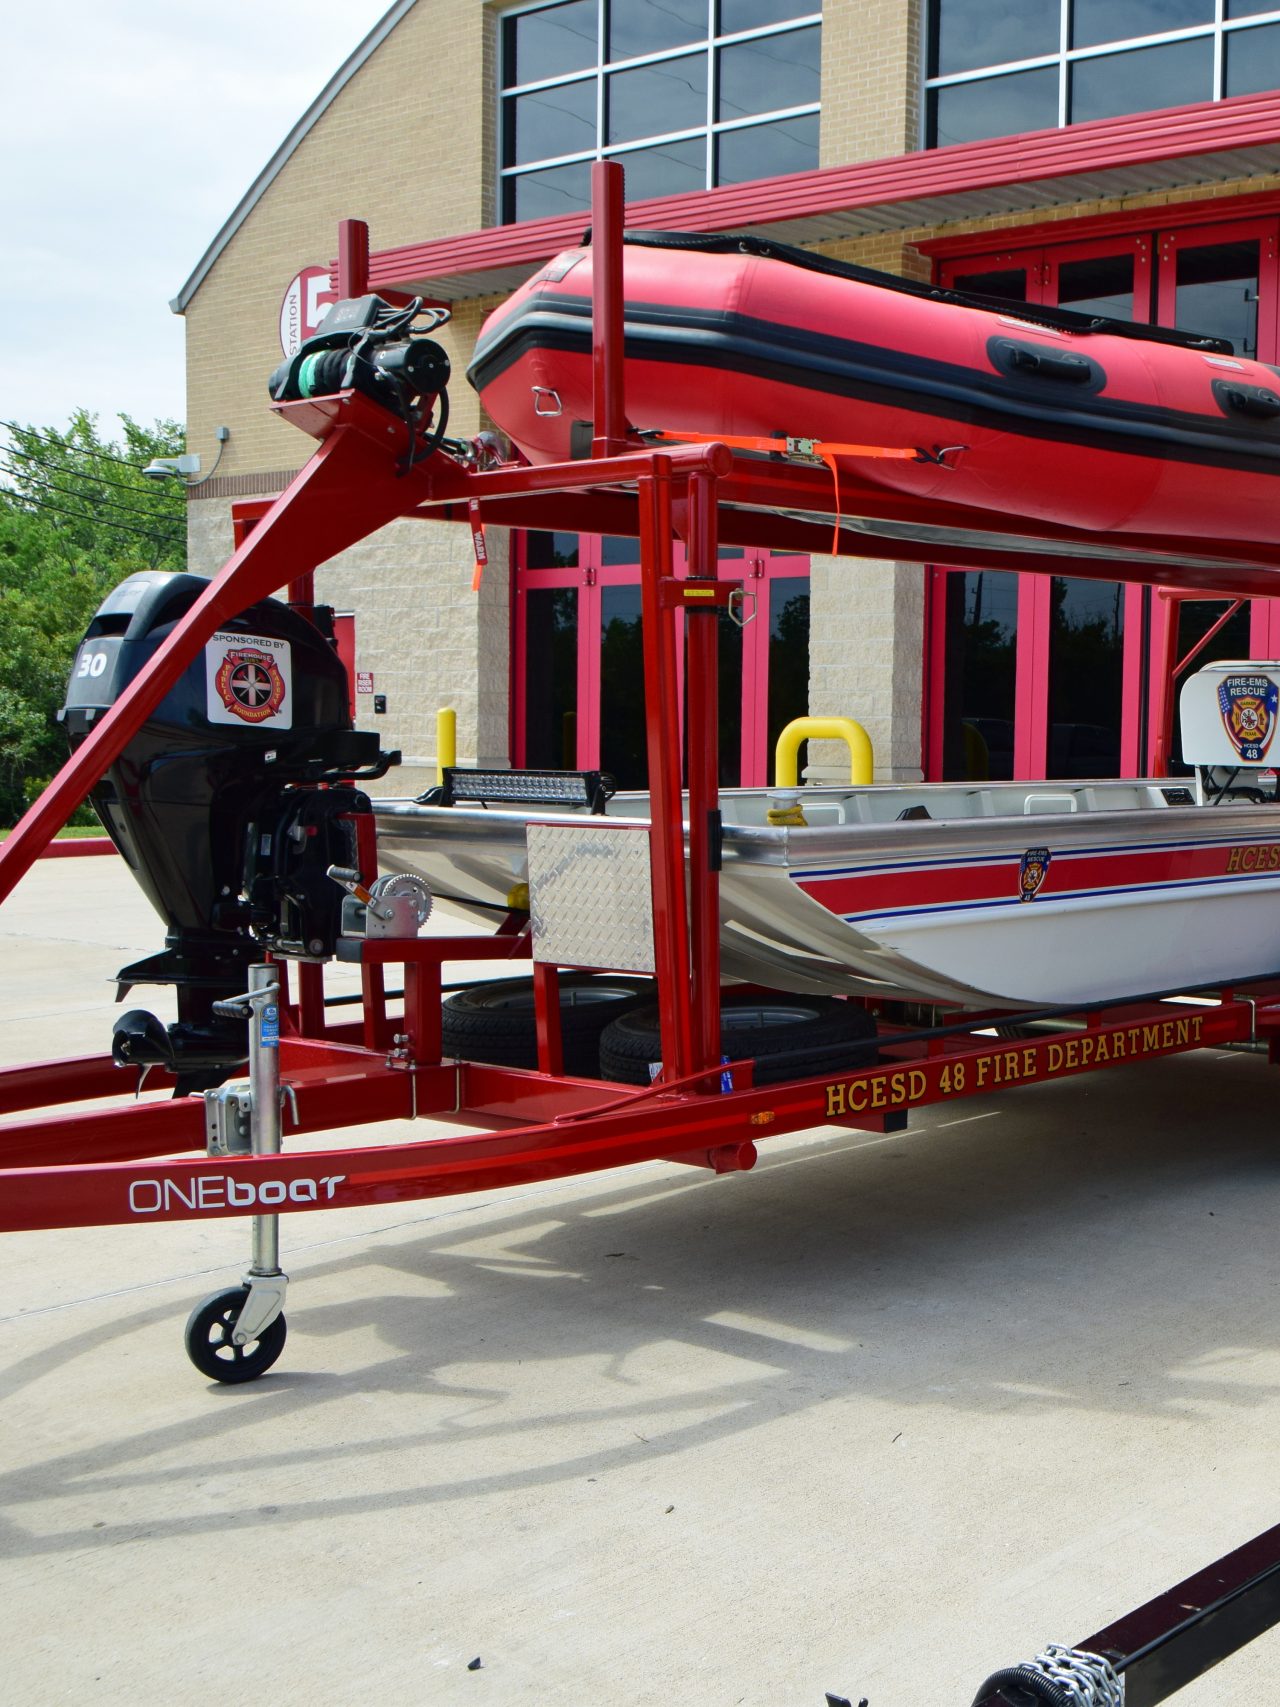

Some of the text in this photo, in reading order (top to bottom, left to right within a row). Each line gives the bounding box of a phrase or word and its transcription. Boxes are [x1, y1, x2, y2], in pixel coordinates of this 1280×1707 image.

[306, 273, 336, 328] 5
[289, 294, 298, 356] STATION
[212, 634, 285, 649] SPONSORED BY
[77, 652, 108, 678] 30
[230, 650, 272, 663] FIREHOUSE
[220, 664, 231, 701] PUBLIC
[272, 669, 281, 705] SAFETY
[1227, 677, 1268, 688] FIRE-EMS
[1230, 687, 1266, 697] RESCUE
[233, 704, 272, 718] FOUNDATION
[1246, 749, 1258, 759] 48
[826, 1015, 1204, 1117] HCESD 48 FIRE DEPARTMENT
[128, 1175, 346, 1213] ONEboat
